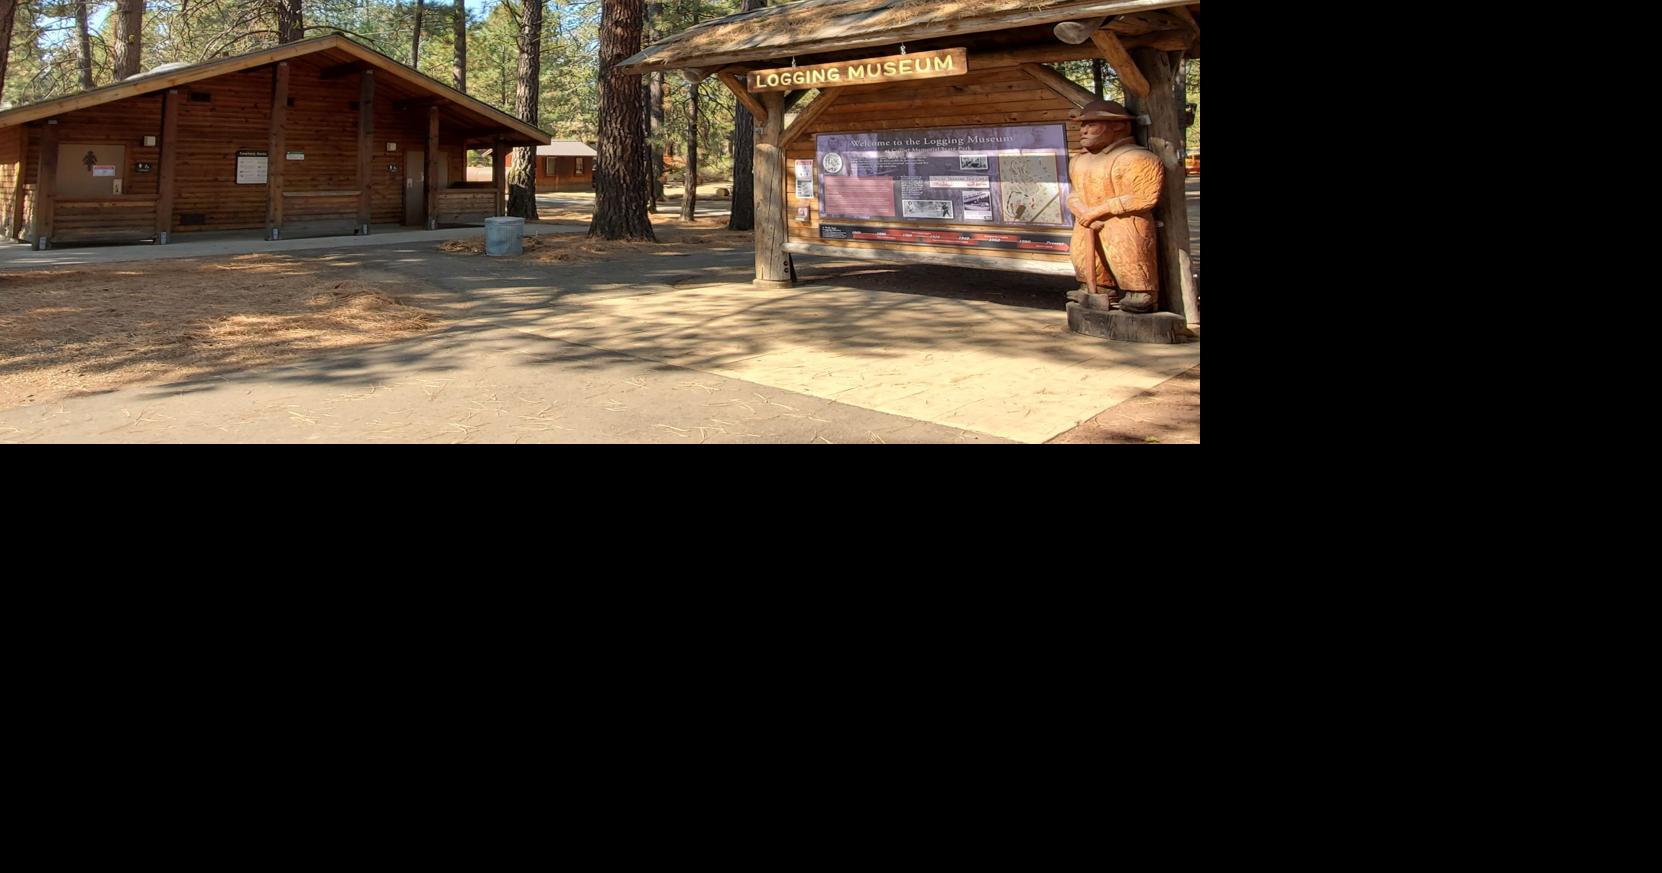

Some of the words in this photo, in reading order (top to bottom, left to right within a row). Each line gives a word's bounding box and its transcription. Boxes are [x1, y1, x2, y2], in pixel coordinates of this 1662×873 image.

[756, 68, 840, 88] LOGGING
[849, 55, 953, 80] MUSEUM
[850, 139, 890, 147] Welcome
[906, 138, 920, 146] the
[924, 137, 964, 146] Logging
[967, 135, 1016, 144] Museum
